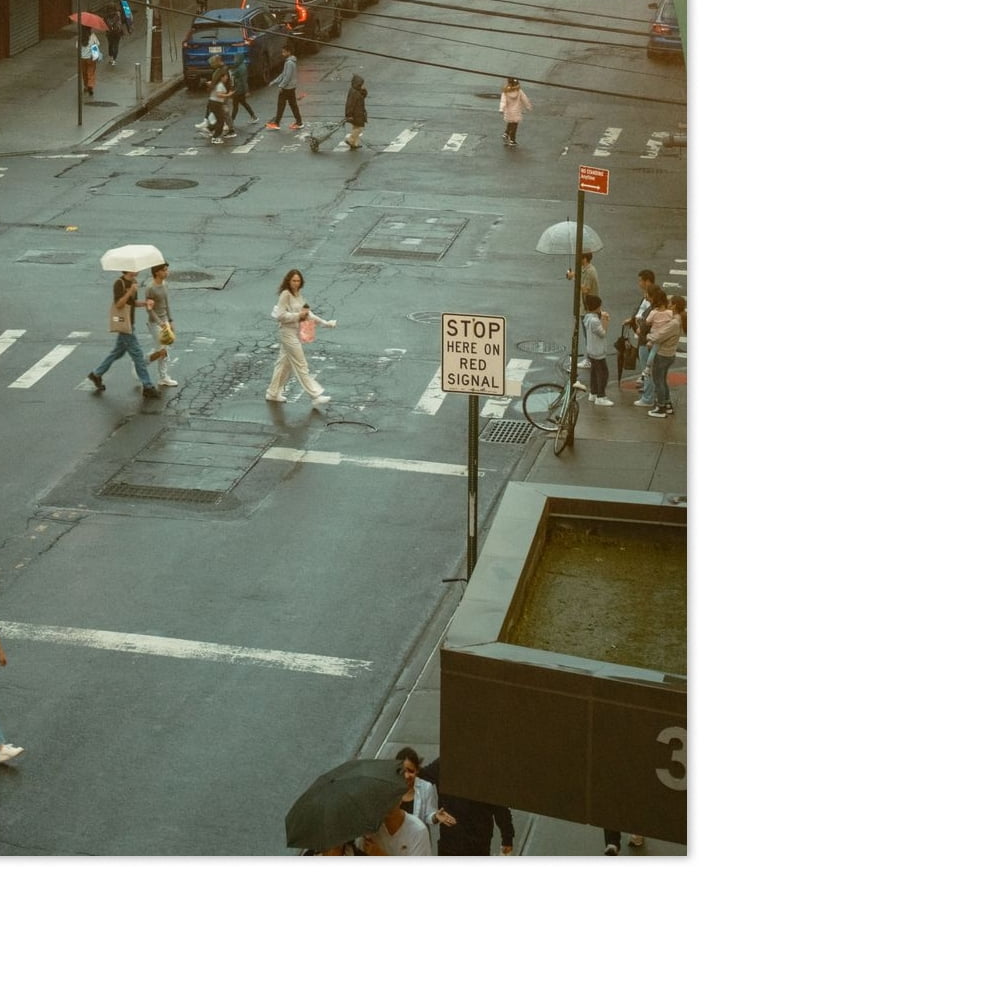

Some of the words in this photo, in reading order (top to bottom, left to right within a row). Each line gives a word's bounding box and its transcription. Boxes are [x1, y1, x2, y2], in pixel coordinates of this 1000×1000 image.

[447, 319, 500, 339] STOP
[447, 340, 478, 354] HERE
[484, 343, 500, 356] ON
[460, 357, 487, 371] RED
[447, 373, 500, 388] SIGNAL
[655, 726, 687, 791] 3
